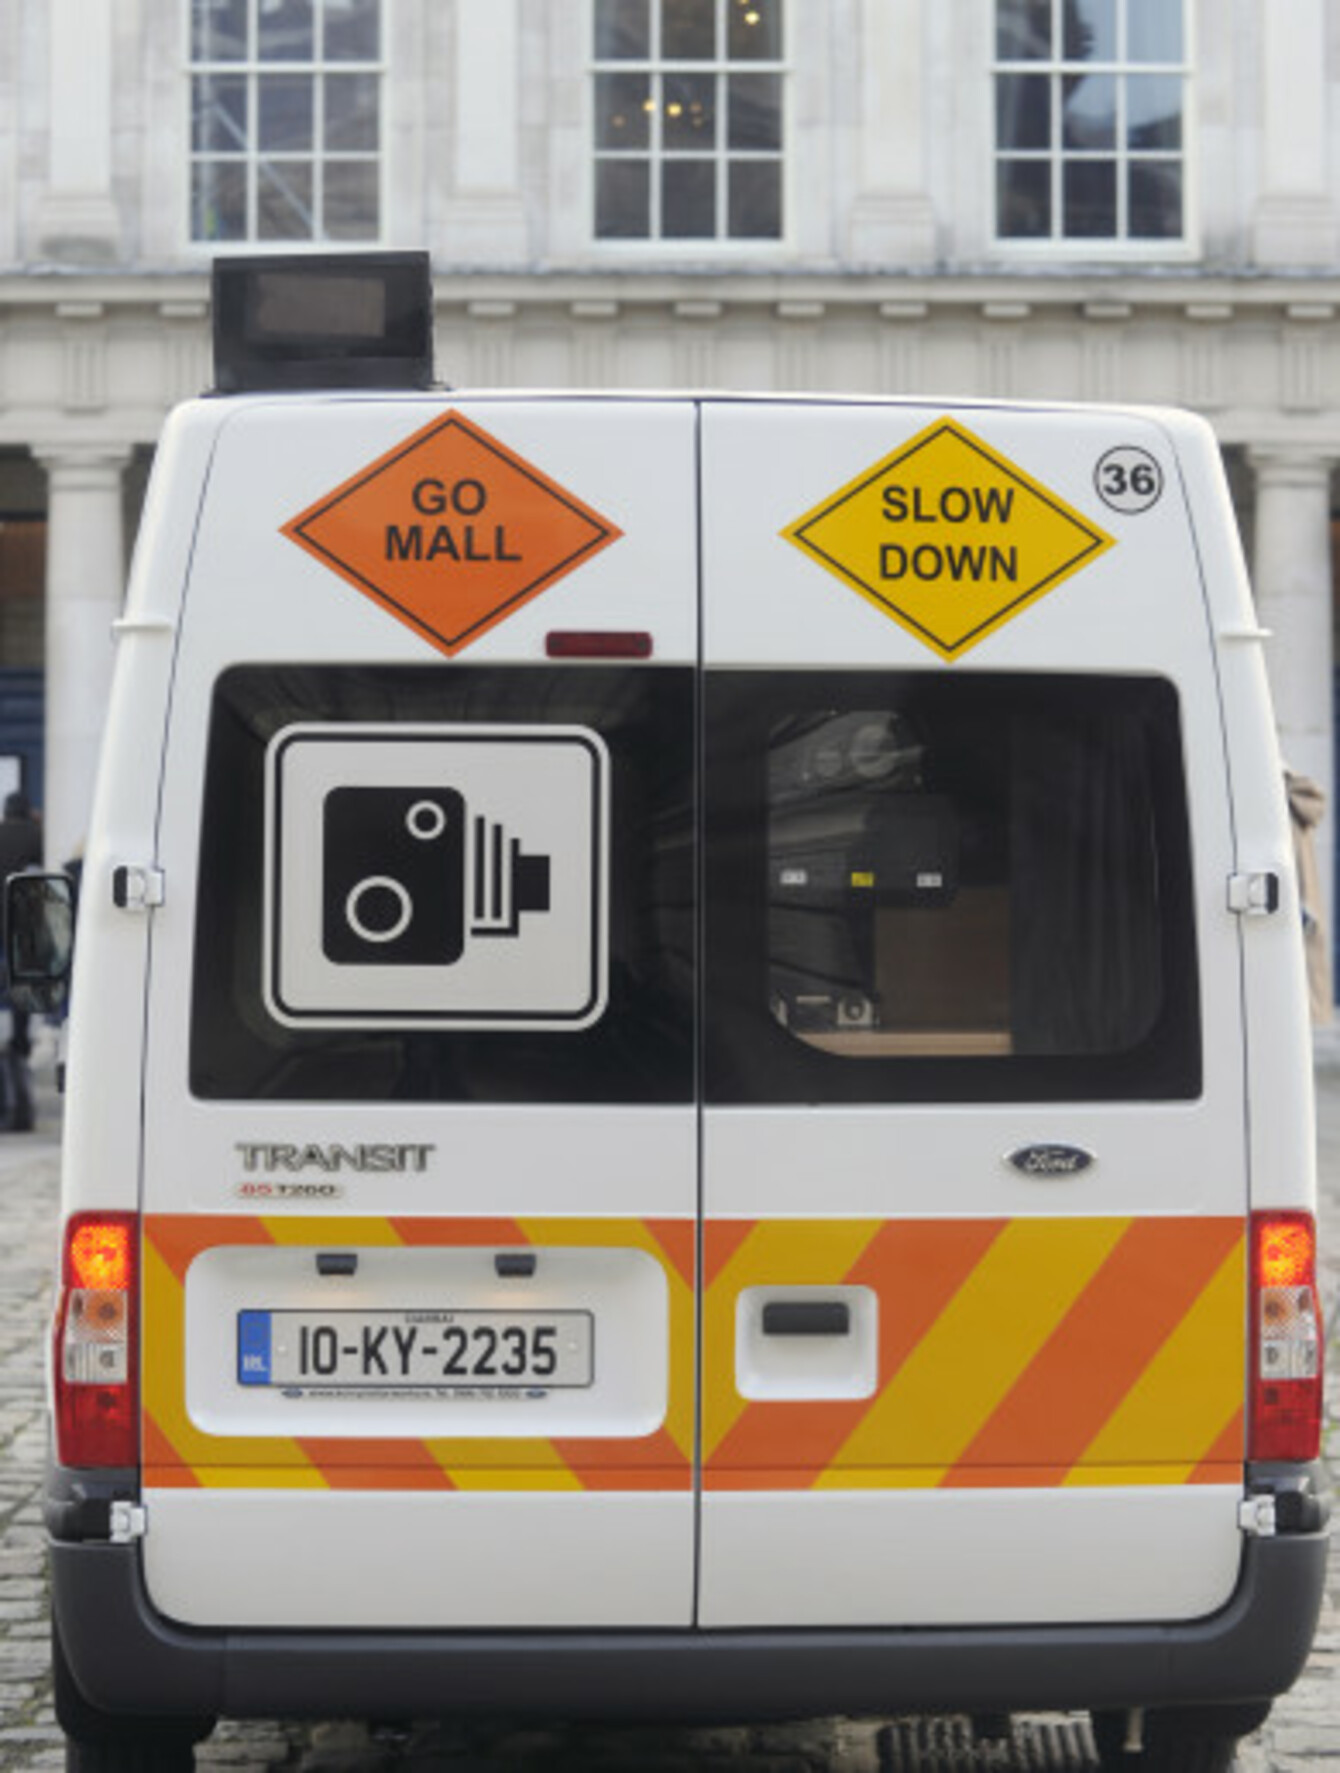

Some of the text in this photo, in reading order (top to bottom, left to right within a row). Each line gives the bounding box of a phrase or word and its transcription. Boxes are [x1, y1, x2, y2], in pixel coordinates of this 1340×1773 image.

[412, 477, 487, 516] GO
[1103, 463, 1155, 496] 36
[881, 484, 1015, 523] SLOW
[384, 524, 523, 562] MALL
[879, 542, 1018, 582] DOWN
[235, 1143, 436, 1173] TRANSIT
[299, 1325, 558, 1376] 10-KY-2235
